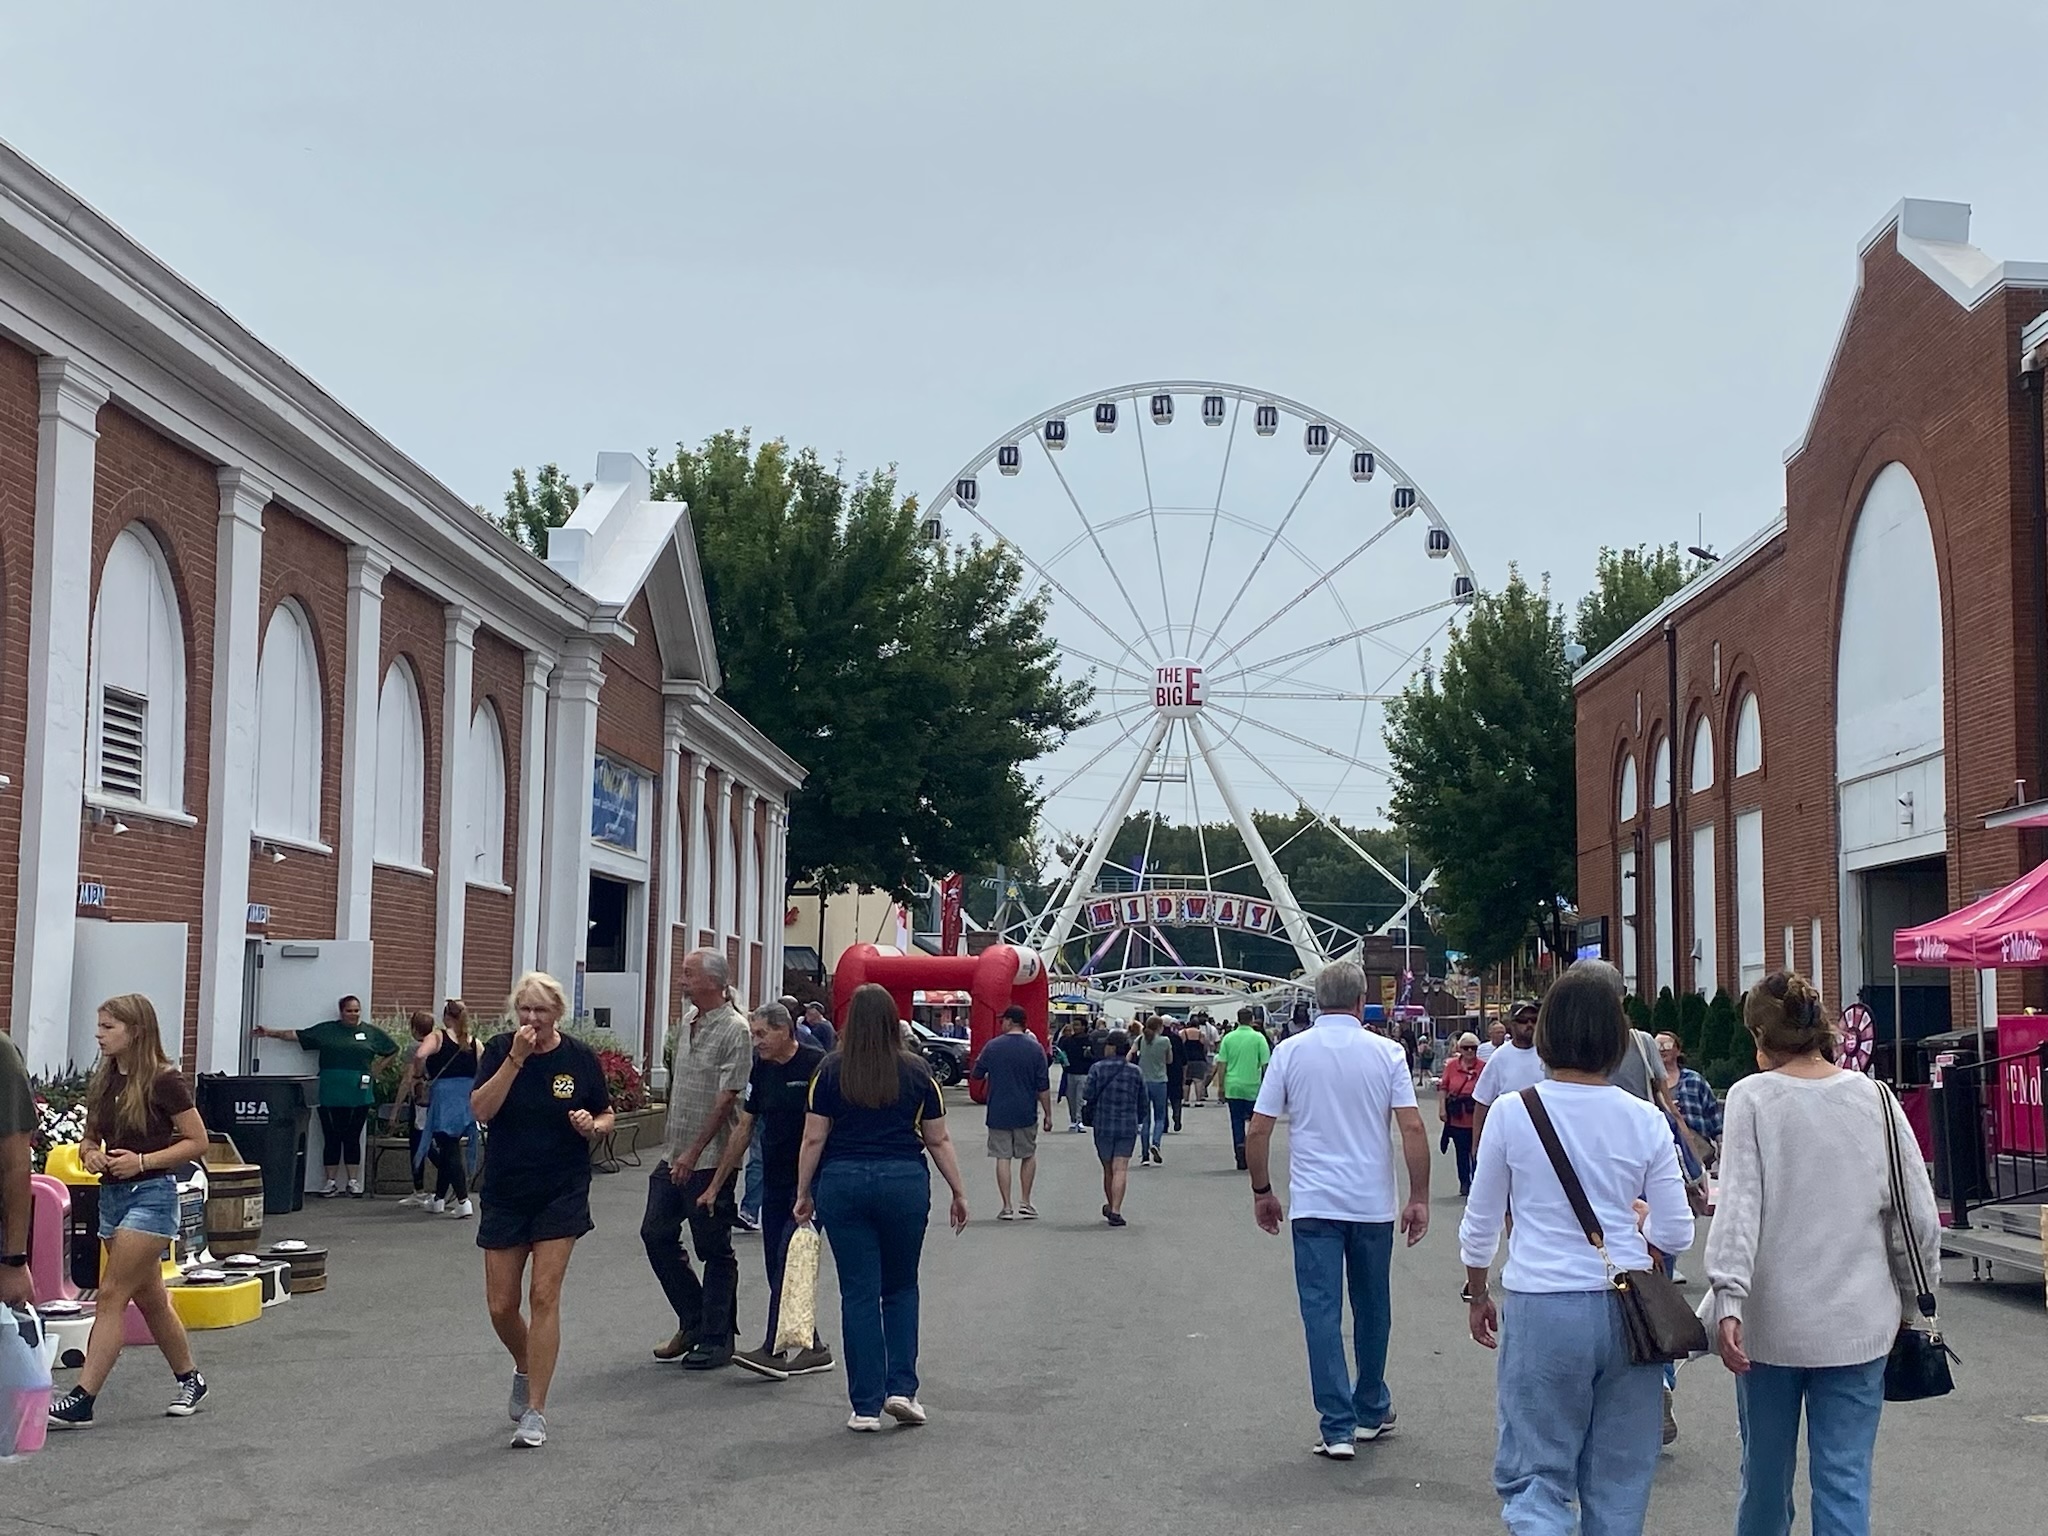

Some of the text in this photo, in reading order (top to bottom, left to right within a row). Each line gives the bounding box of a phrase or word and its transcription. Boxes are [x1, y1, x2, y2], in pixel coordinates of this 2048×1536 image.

[1156, 667, 1182, 684] THE
[1185, 667, 1203, 706] E
[1156, 687, 1183, 707] BIG
[79, 883, 105, 905] MEN
[1093, 897, 1267, 927] MIDWAY
[1048, 981, 1086, 999] EMONADE
[234, 1101, 270, 1115] USA
